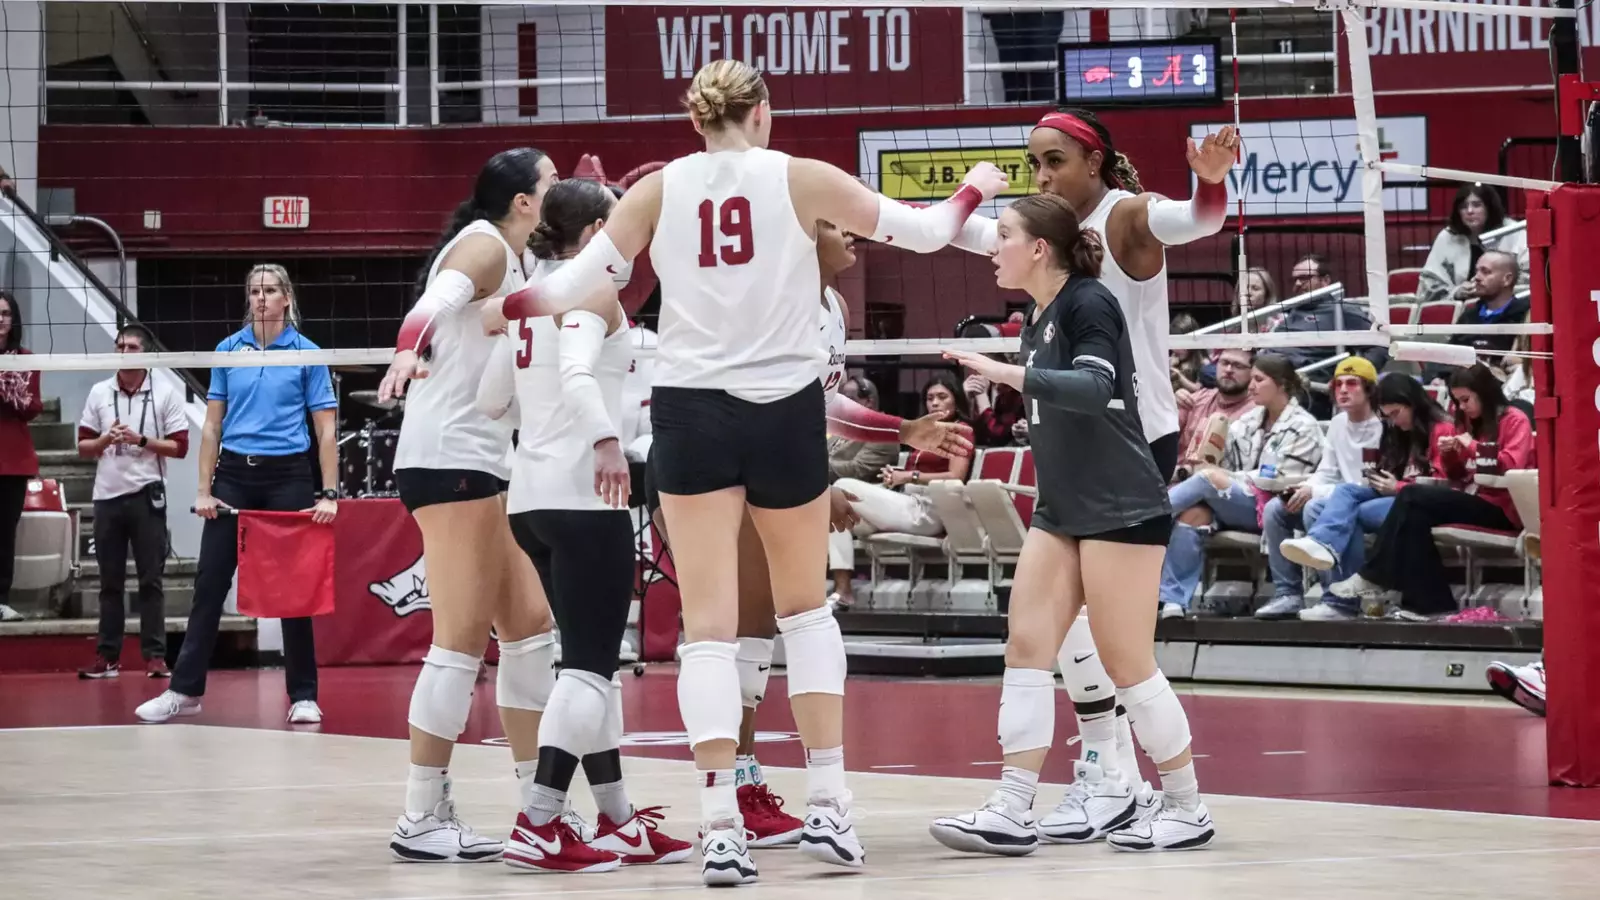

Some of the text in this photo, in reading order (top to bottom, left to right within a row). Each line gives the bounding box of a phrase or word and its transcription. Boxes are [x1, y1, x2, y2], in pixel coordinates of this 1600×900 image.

[862, 8, 910, 72] TO
[1278, 40, 1292, 54] 11
[1127, 56, 1143, 88] 3
[1192, 54, 1208, 86] 3
[923, 165, 960, 184] J.B.
[272, 199, 304, 225] EXIT
[698, 196, 755, 268] 19
